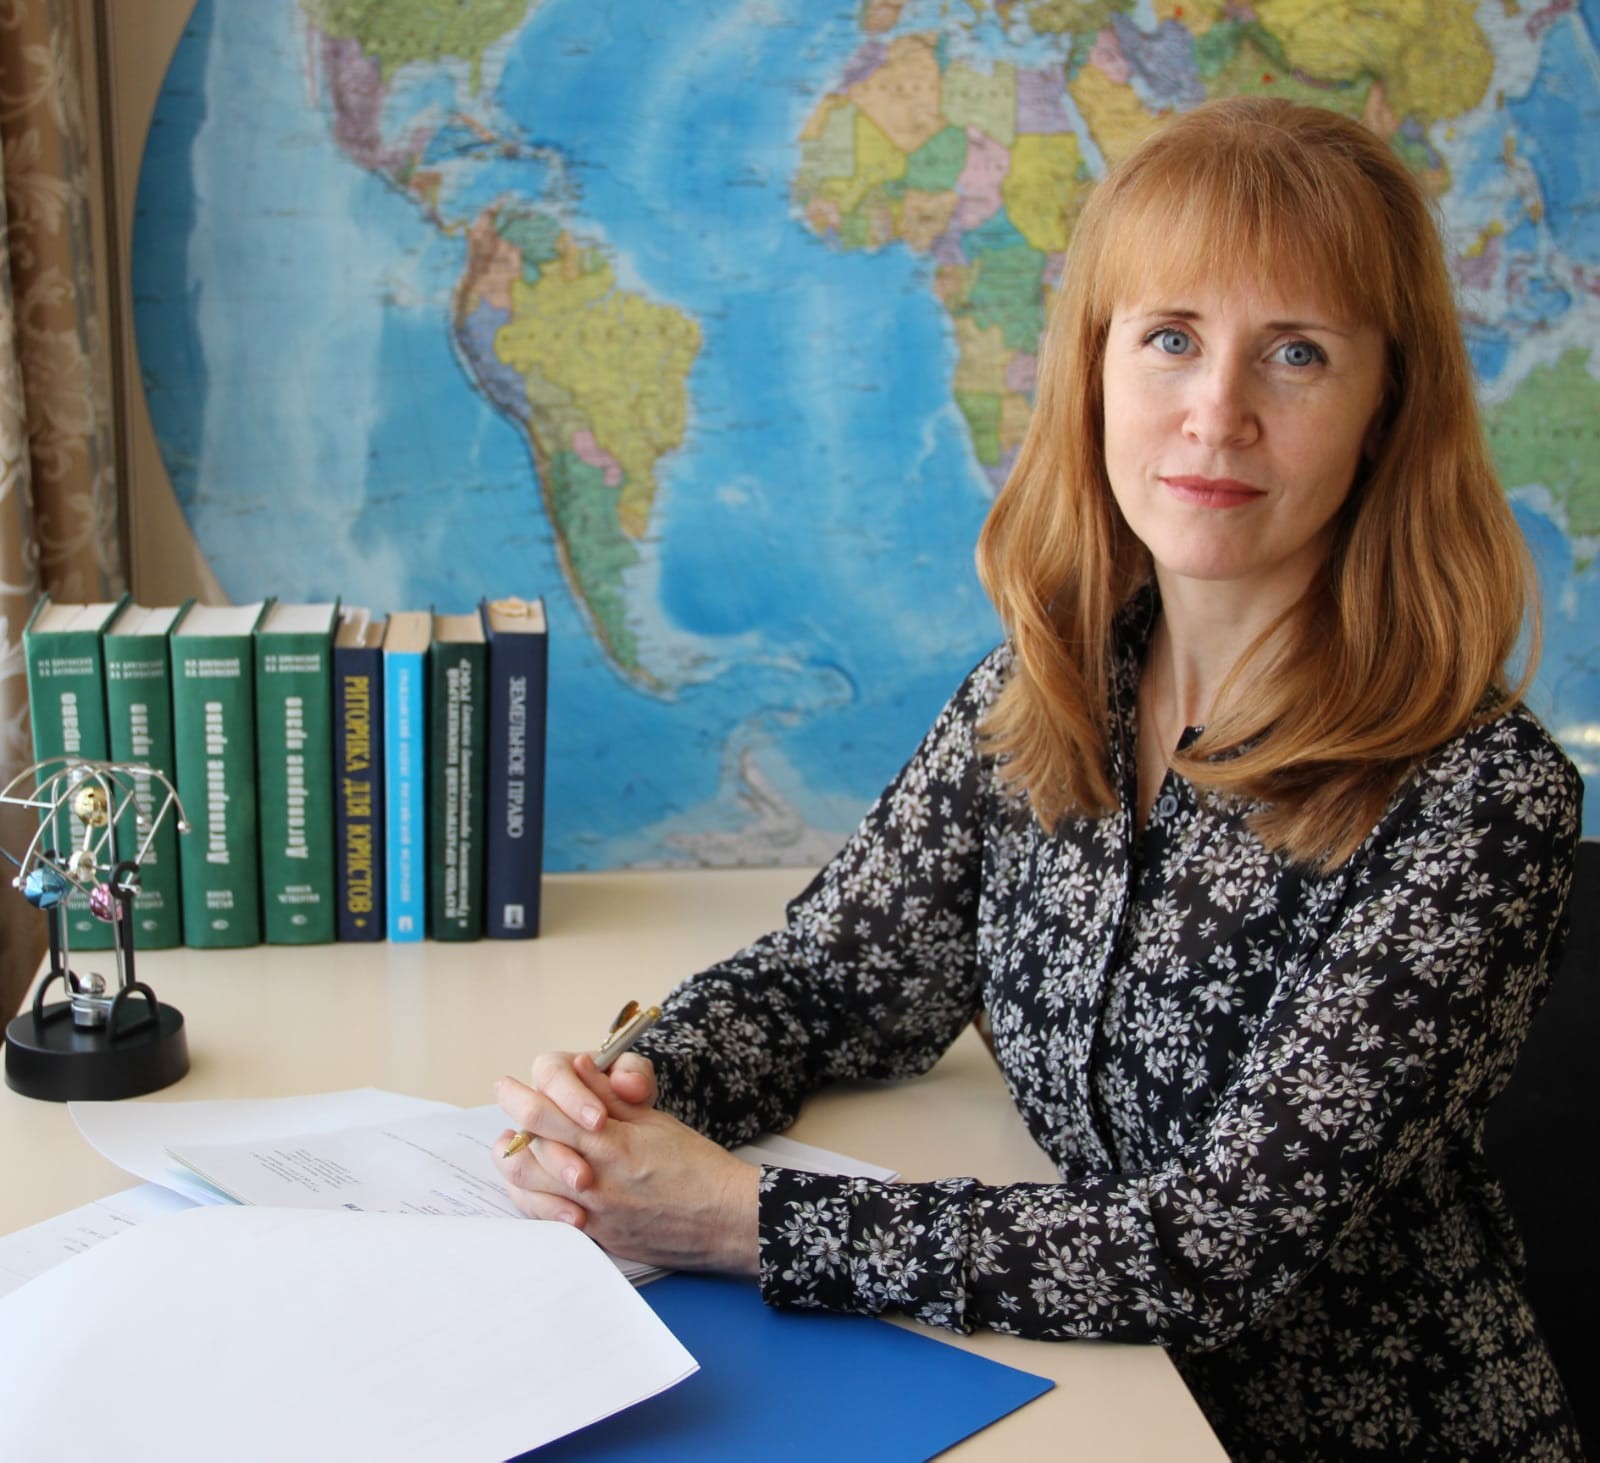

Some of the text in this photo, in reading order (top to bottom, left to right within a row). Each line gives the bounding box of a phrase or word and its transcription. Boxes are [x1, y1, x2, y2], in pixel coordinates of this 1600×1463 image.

[60, 692, 81, 751] право
[130, 703, 153, 755] право
[205, 701, 228, 754] право
[285, 696, 308, 749] право
[506, 676, 527, 839] ЗЕМЕЛЬНОЕ ПРАВО
[206, 760, 230, 864] Договорное
[285, 755, 309, 858] Договорное
[343, 676, 373, 913] РИТОРИКА ДЛЯ ЮРИСТОВ
